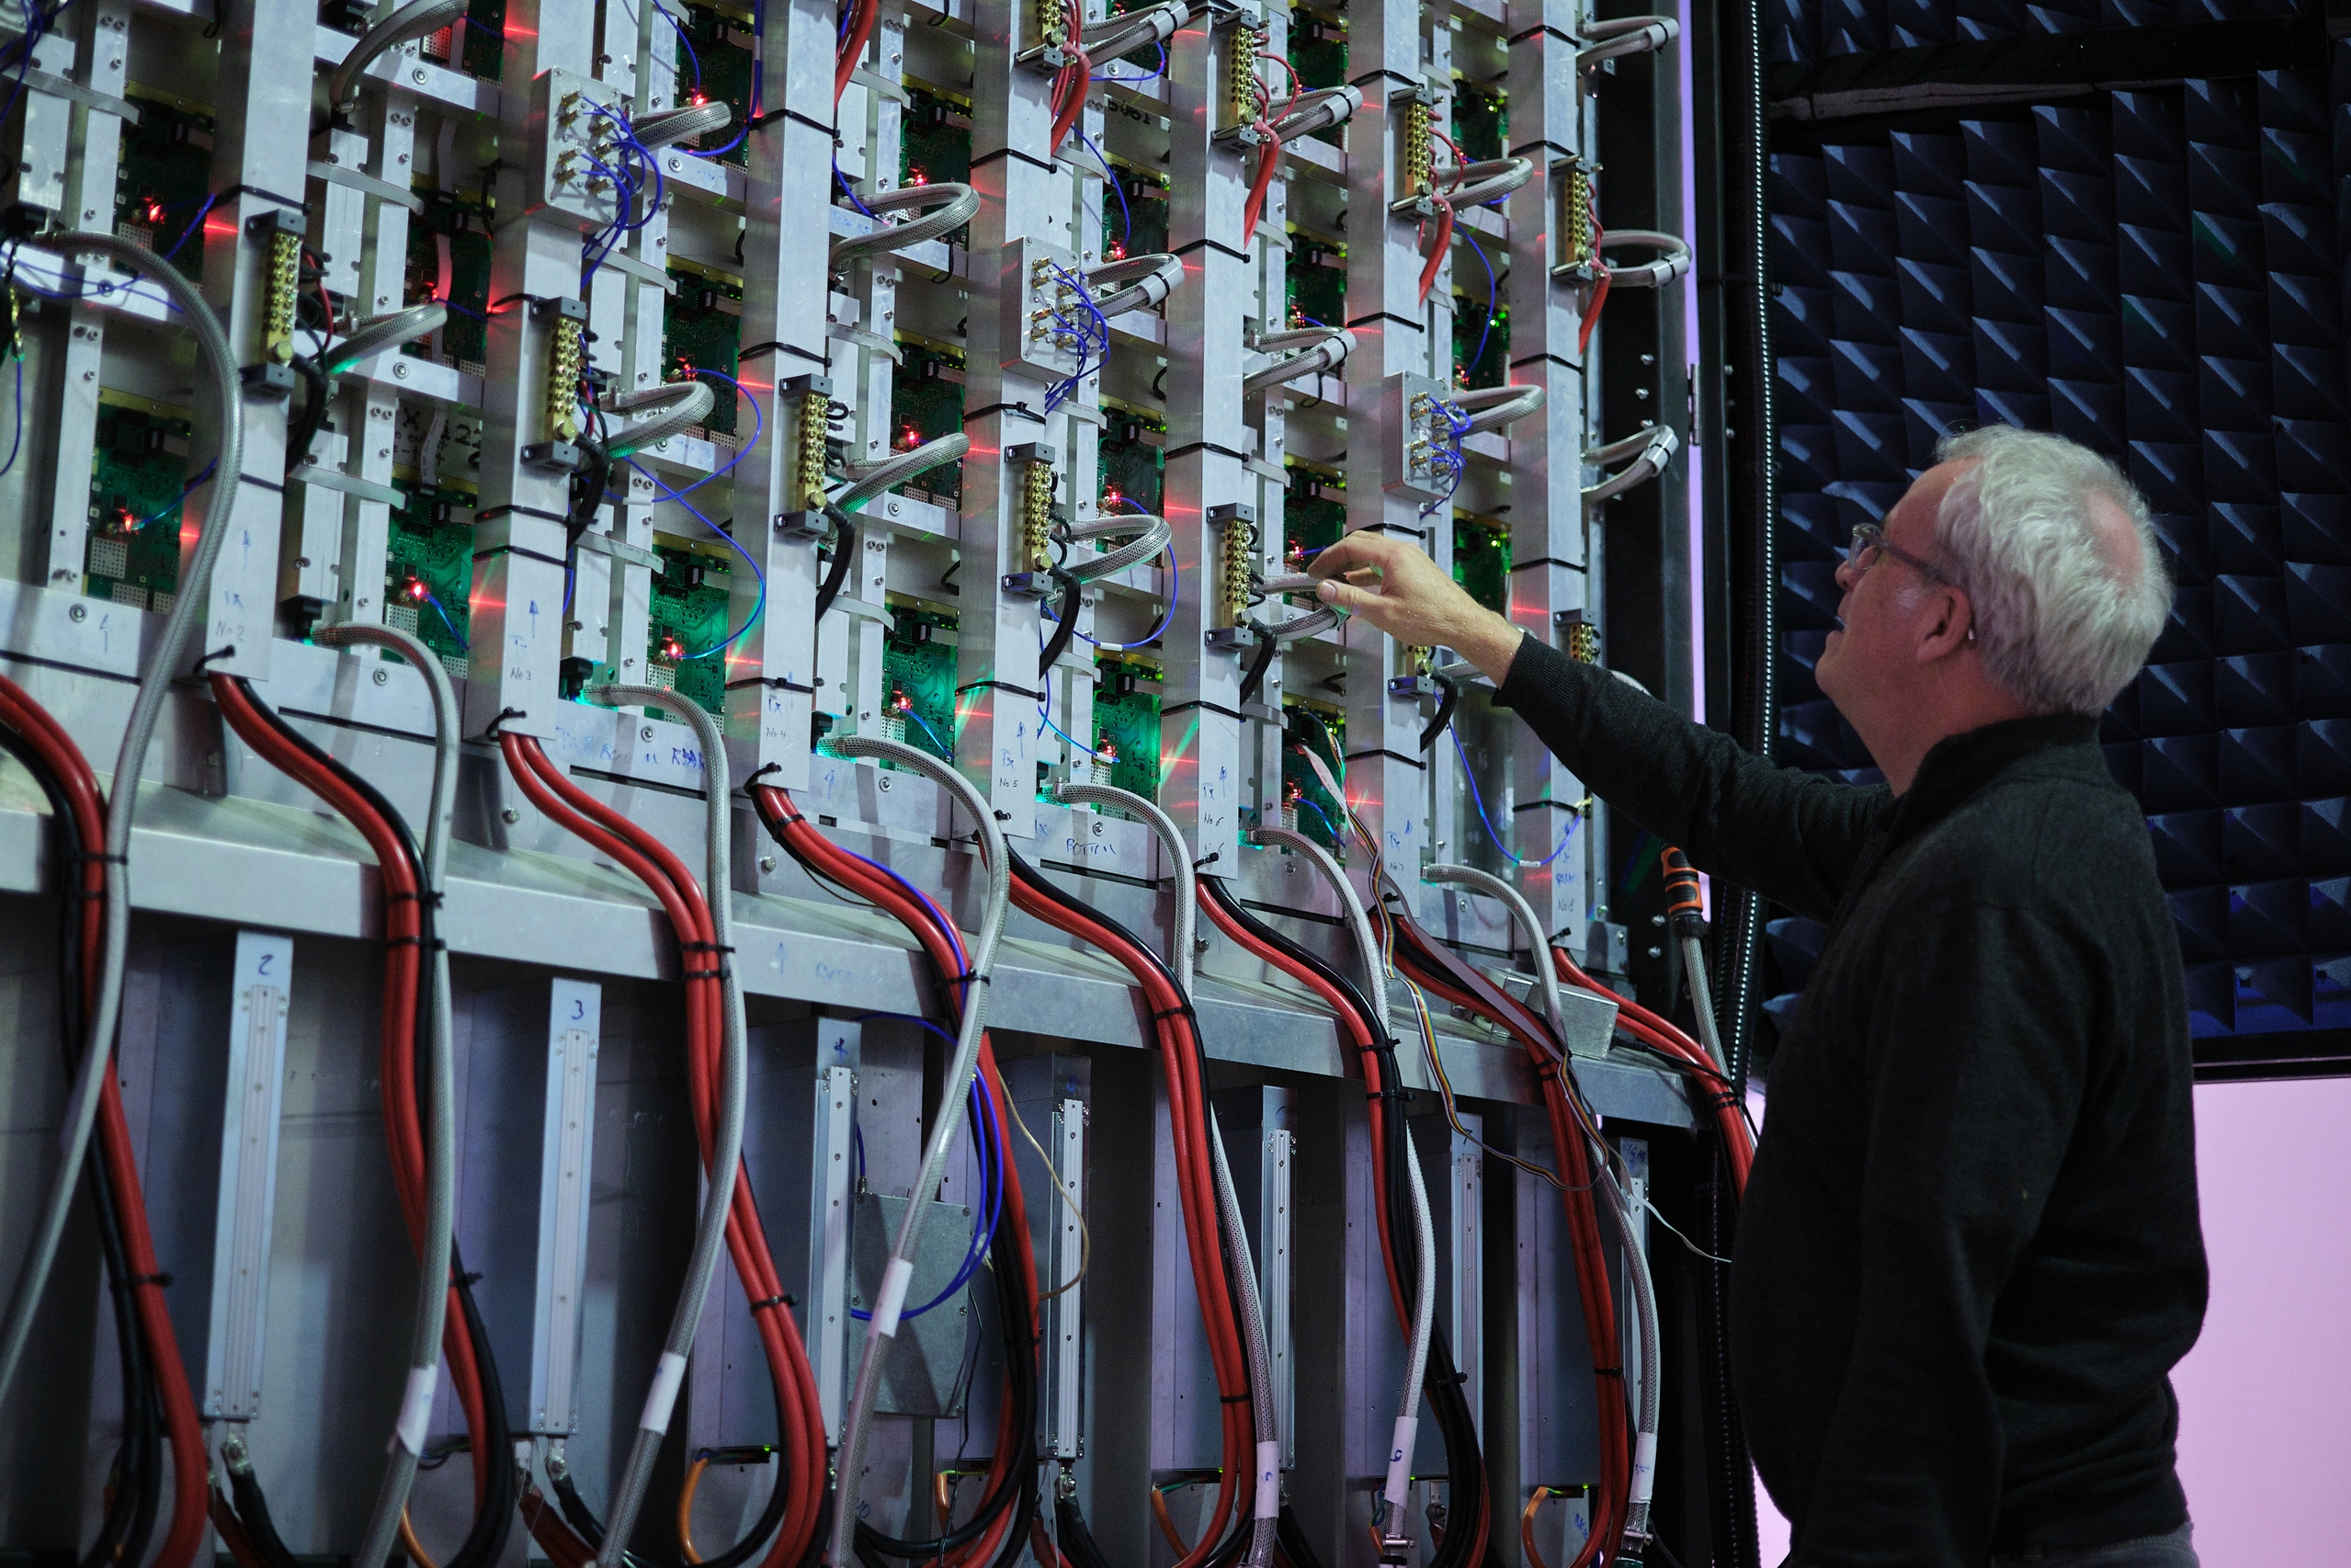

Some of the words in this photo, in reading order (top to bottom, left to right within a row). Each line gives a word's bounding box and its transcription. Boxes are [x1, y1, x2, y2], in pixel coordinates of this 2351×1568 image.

[1000, 747, 1016, 771] Tx
[999, 777, 1010, 788] No
[258, 952, 275, 976] 2
[571, 998, 585, 1021] 3
